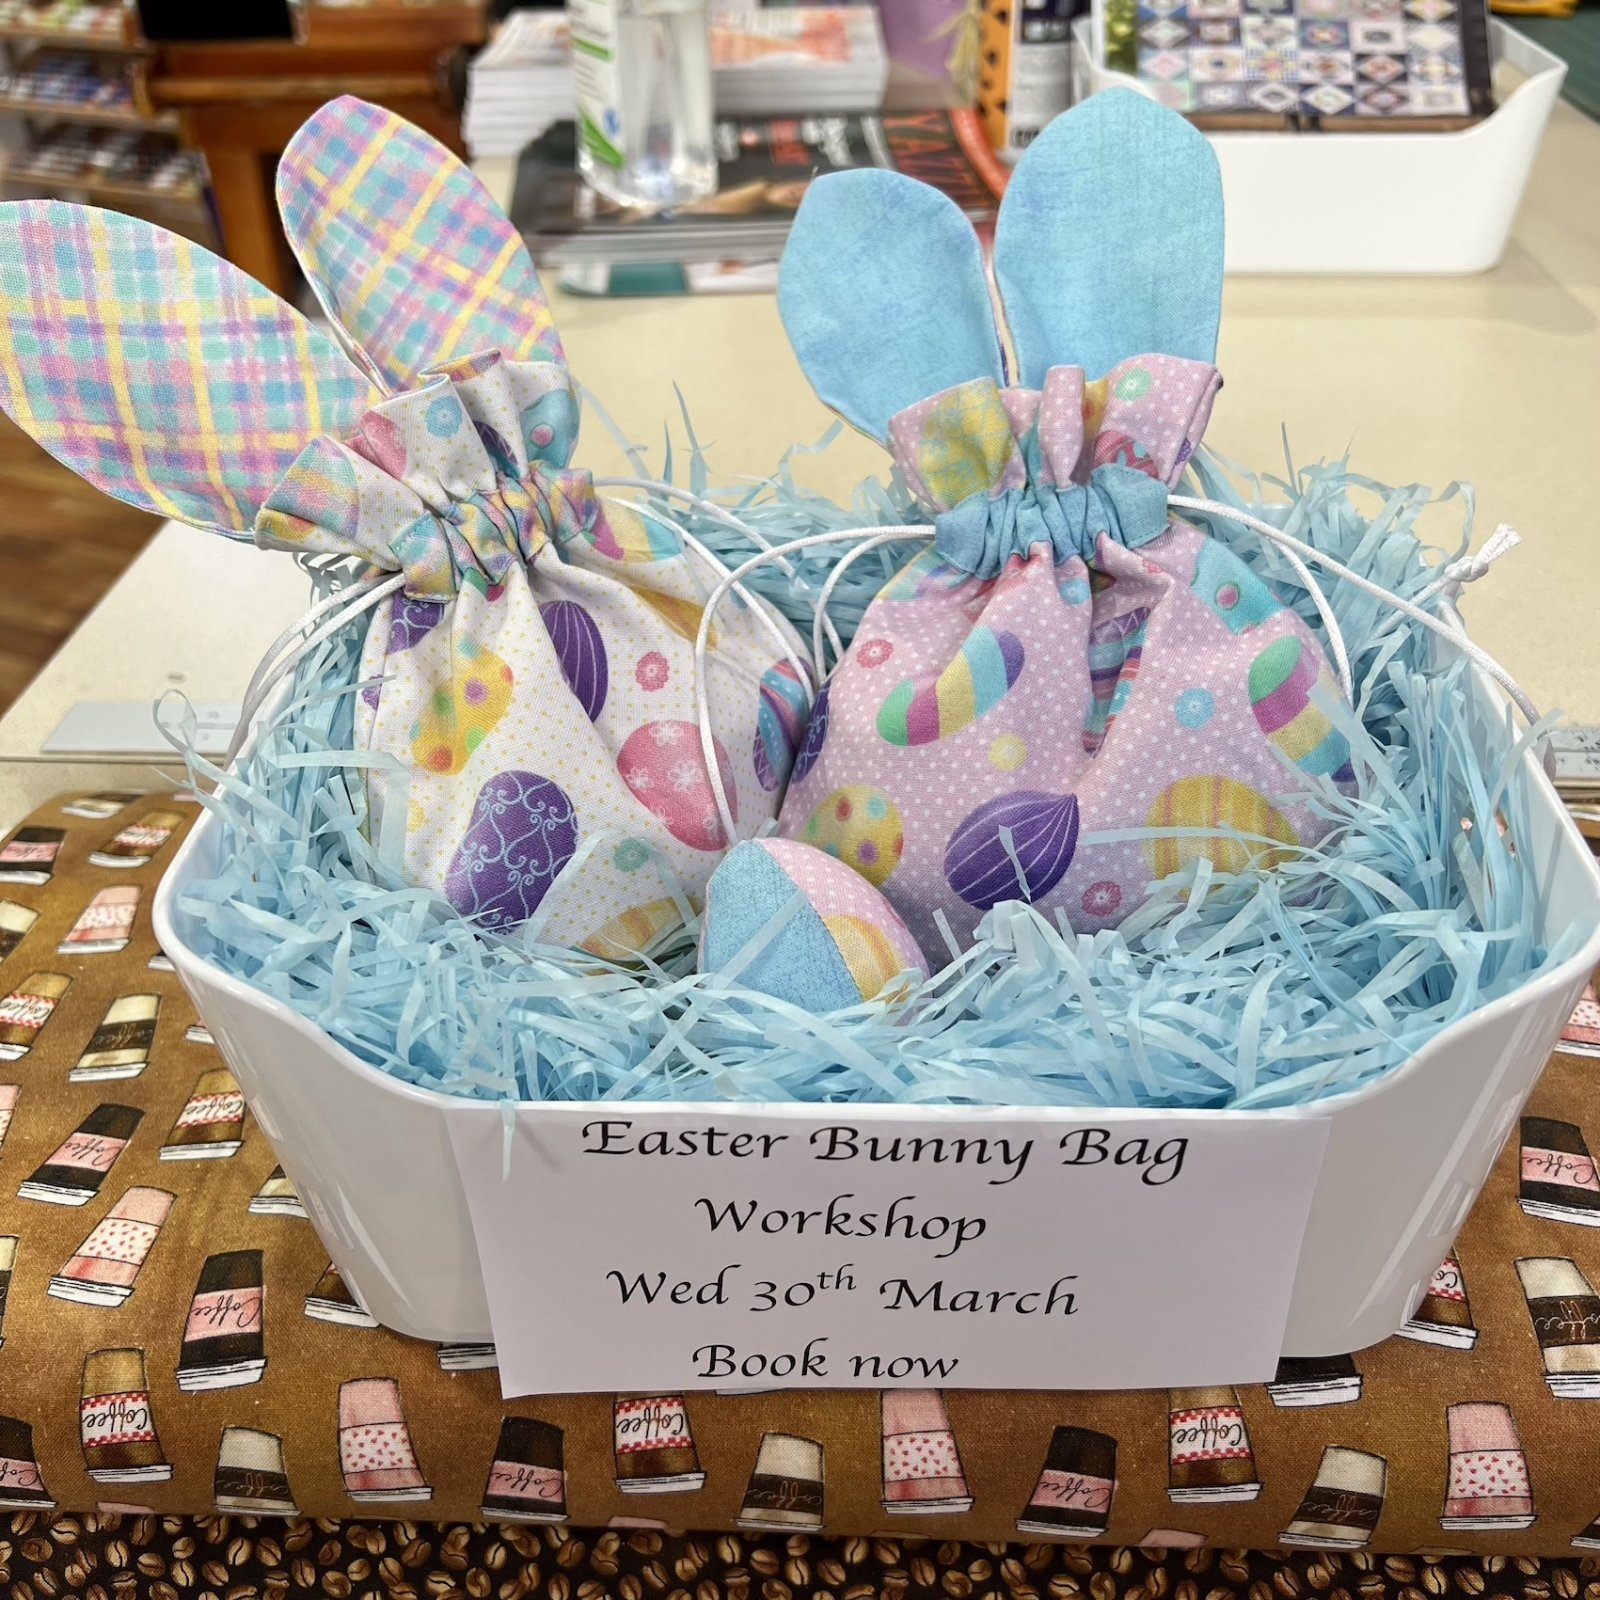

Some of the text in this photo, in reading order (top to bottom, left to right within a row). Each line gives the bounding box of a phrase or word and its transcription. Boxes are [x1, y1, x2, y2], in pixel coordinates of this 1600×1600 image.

[185, 1098, 243, 1118] Coffee
[65, 1138, 124, 1166] Coffee
[581, 1121, 1189, 1186] Easter Bunny Bag
[1521, 1153, 1595, 1184] Coffee
[694, 1193, 987, 1259] Workshop
[605, 1263, 1079, 1316] Wed 30th March
[191, 1294, 262, 1328] Coffee
[1535, 1301, 1600, 1340] offee
[692, 1337, 959, 1379] Book now
[83, 1401, 148, 1433] Coffee
[617, 1406, 684, 1438] Coffee
[1172, 1416, 1242, 1448] Coffee
[490, 1468, 562, 1498] Coffee
[1039, 1477, 1112, 1508] Coffee
